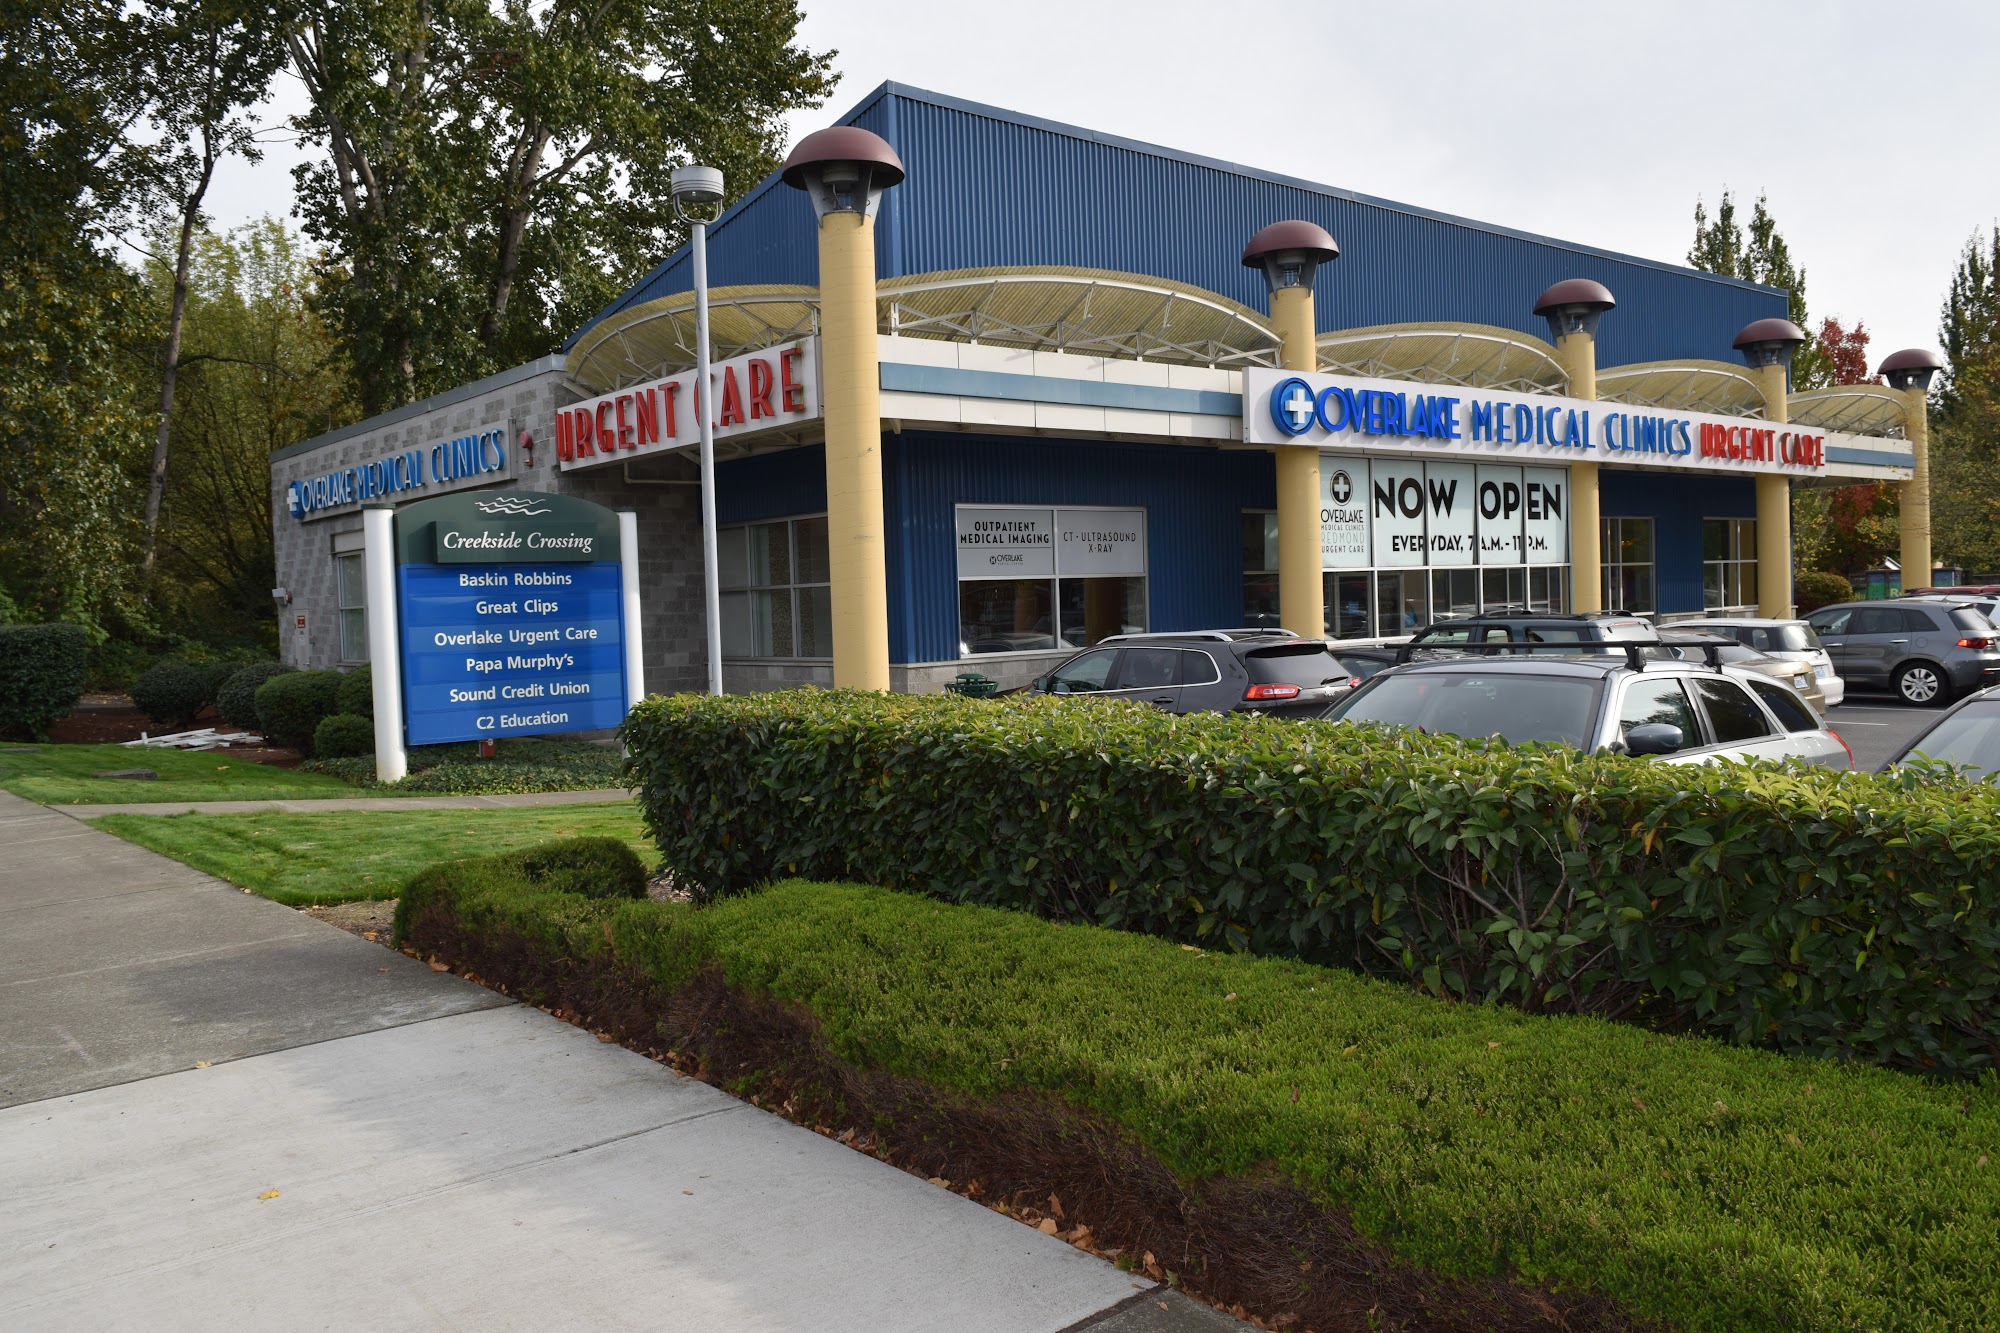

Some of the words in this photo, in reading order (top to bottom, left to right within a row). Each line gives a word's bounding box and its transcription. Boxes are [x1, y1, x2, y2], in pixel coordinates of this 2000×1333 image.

[555, 381, 680, 462] URGENT
[1317, 386, 1462, 440] OVERLAKE
[1471, 399, 1596, 450] MEDICAL
[1604, 412, 1692, 456] CLINICS
[1700, 422, 1776, 462] URGENT
[1780, 431, 1825, 467] CARE
[301, 467, 356, 513] OVERLAKE
[356, 450, 426, 500] MEDICAL
[430, 428, 505, 484] CLINICS
[1374, 477, 1458, 519] NOW
[1479, 481, 1562, 521] OPEN
[1320, 508, 1364, 523] OVERLAKE
[974, 521, 1036, 532] OUTPATIENT
[443, 531, 522, 549] Creekside
[527, 532, 593, 553] Crossing
[960, 533, 1005, 544] MEDICAL
[1008, 533, 1050, 544] IMAGING
[1063, 532, 1074, 542] CT
[1081, 532, 1137, 542] ULTRASOUND
[1321, 532, 1365, 544] REDMOND
[1392, 535, 1464, 553] EVERYDAY,
[1088, 544, 1113, 553] X-RAY
[1322, 545, 1346, 553] URGENT
[1348, 545, 1365, 553] CARE
[997, 554, 1024, 562] OVERLAKE
[459, 573, 508, 587] Baskin
[514, 572, 572, 586] Robbins
[475, 601, 518, 615] Great
[524, 600, 559, 615] Clips
[434, 630, 503, 647] Overlake
[509, 629, 560, 645] Urgent
[565, 627, 598, 641] Care
[466, 658, 503, 674] Papa
[450, 686, 496, 703] Sound
[501, 684, 544, 699] Credit
[550, 681, 590, 696] Union
[476, 716, 495, 730] C2
[500, 711, 569, 728] Education
